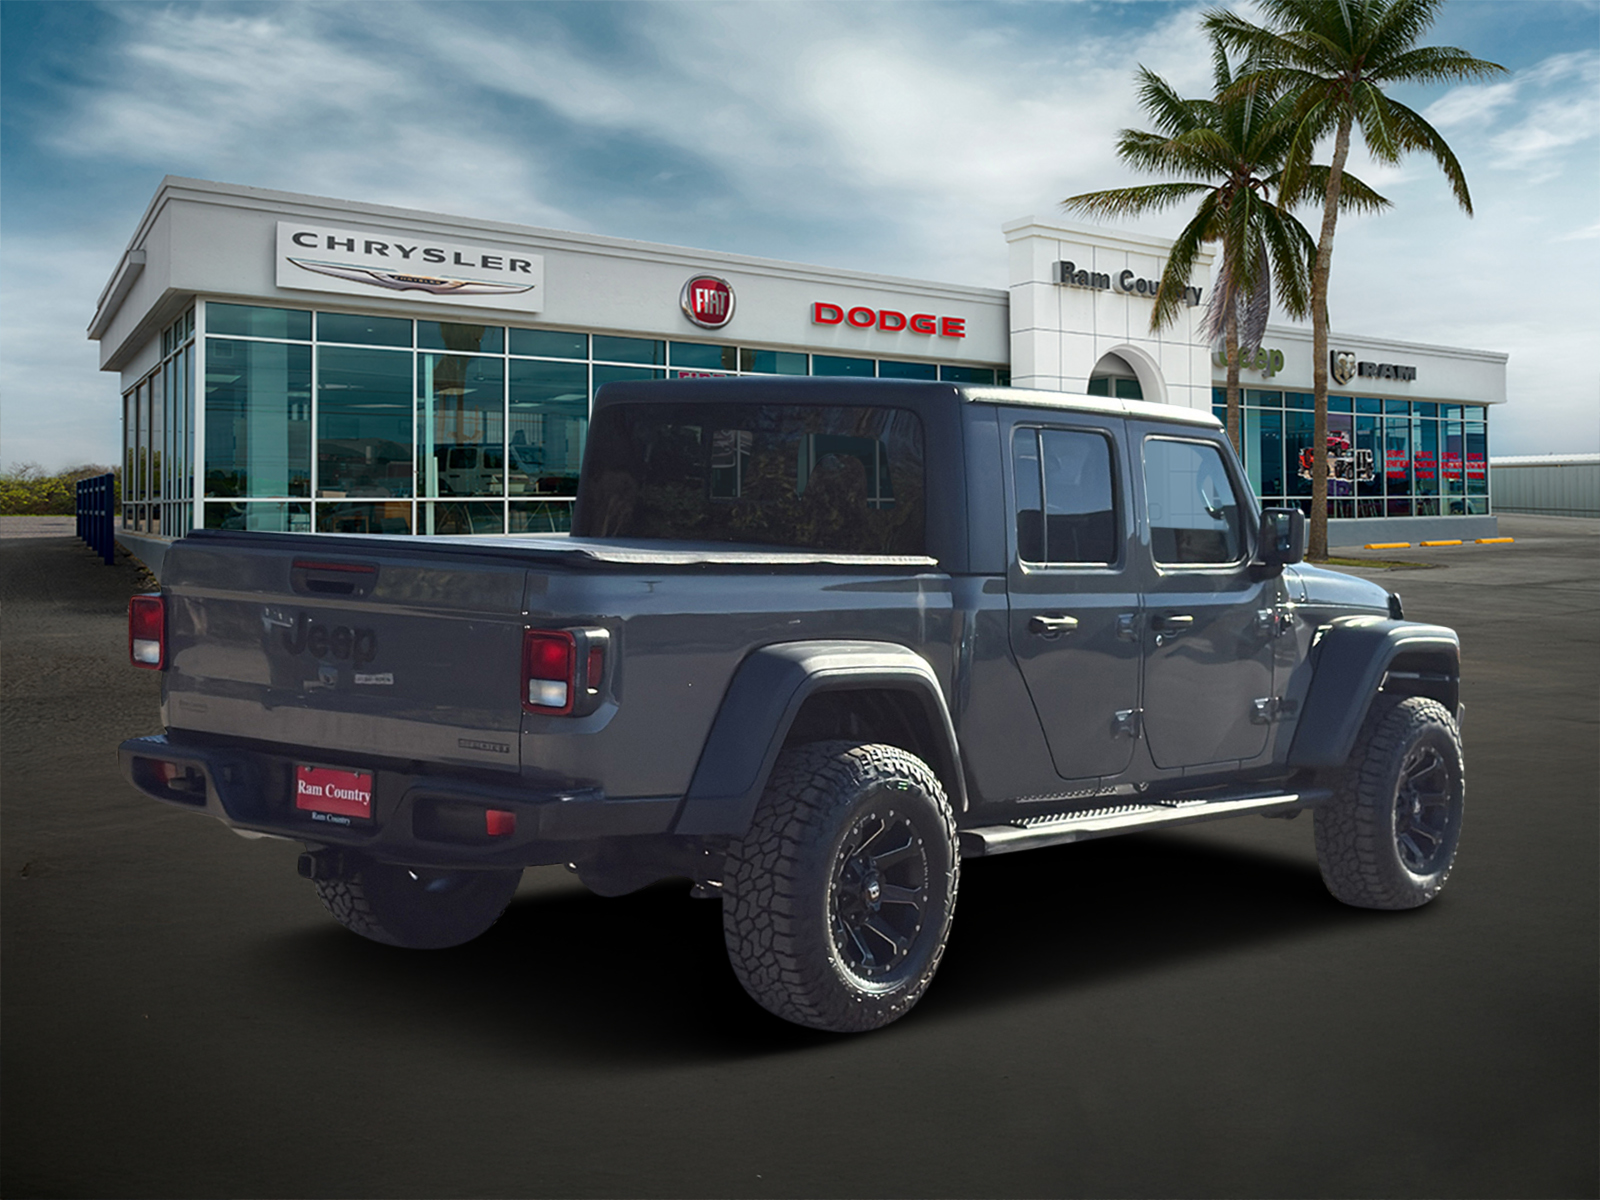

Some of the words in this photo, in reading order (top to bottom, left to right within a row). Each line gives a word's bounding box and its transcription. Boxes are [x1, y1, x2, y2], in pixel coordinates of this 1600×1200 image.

[292, 232, 532, 273] CHRYSLER
[1053, 260, 1110, 290] Ram
[1113, 269, 1203, 307] Coury
[695, 287, 728, 316] FIAT
[812, 301, 967, 338] DODGE
[1358, 361, 1417, 381] RAM
[282, 611, 379, 671] Jeep
[297, 780, 323, 797] Ram
[325, 783, 371, 805] Country
[312, 811, 326, 821] Ram
[326, 813, 351, 826] Country
